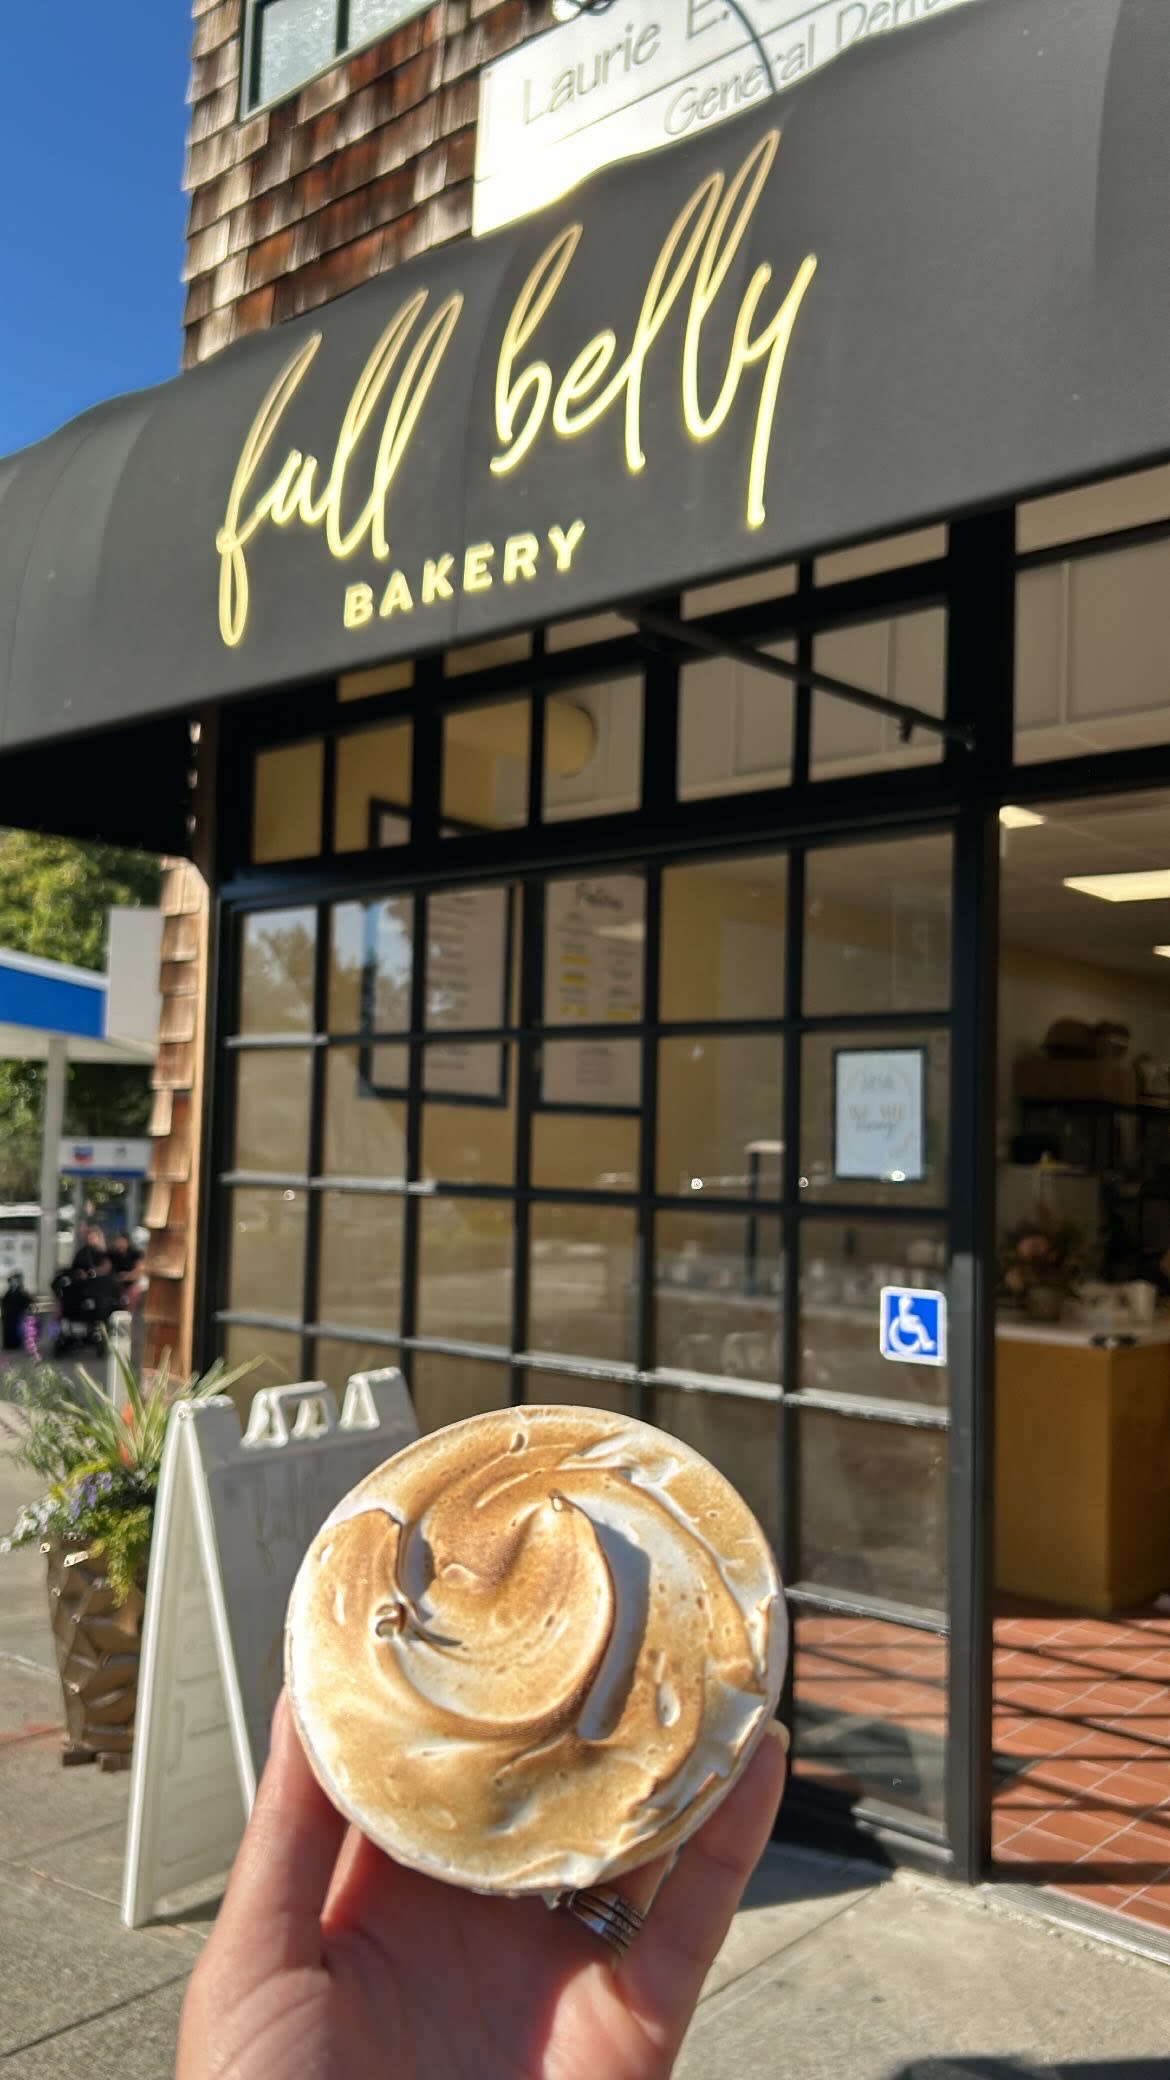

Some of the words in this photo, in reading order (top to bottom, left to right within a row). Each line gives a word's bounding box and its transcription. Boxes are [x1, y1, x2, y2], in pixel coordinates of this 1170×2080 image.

[522, 20, 662, 128] Laurie
[663, 22, 817, 136] General
[215, 288, 464, 648] full
[489, 128, 819, 531] belly
[342, 518, 587, 630] BAKERY
